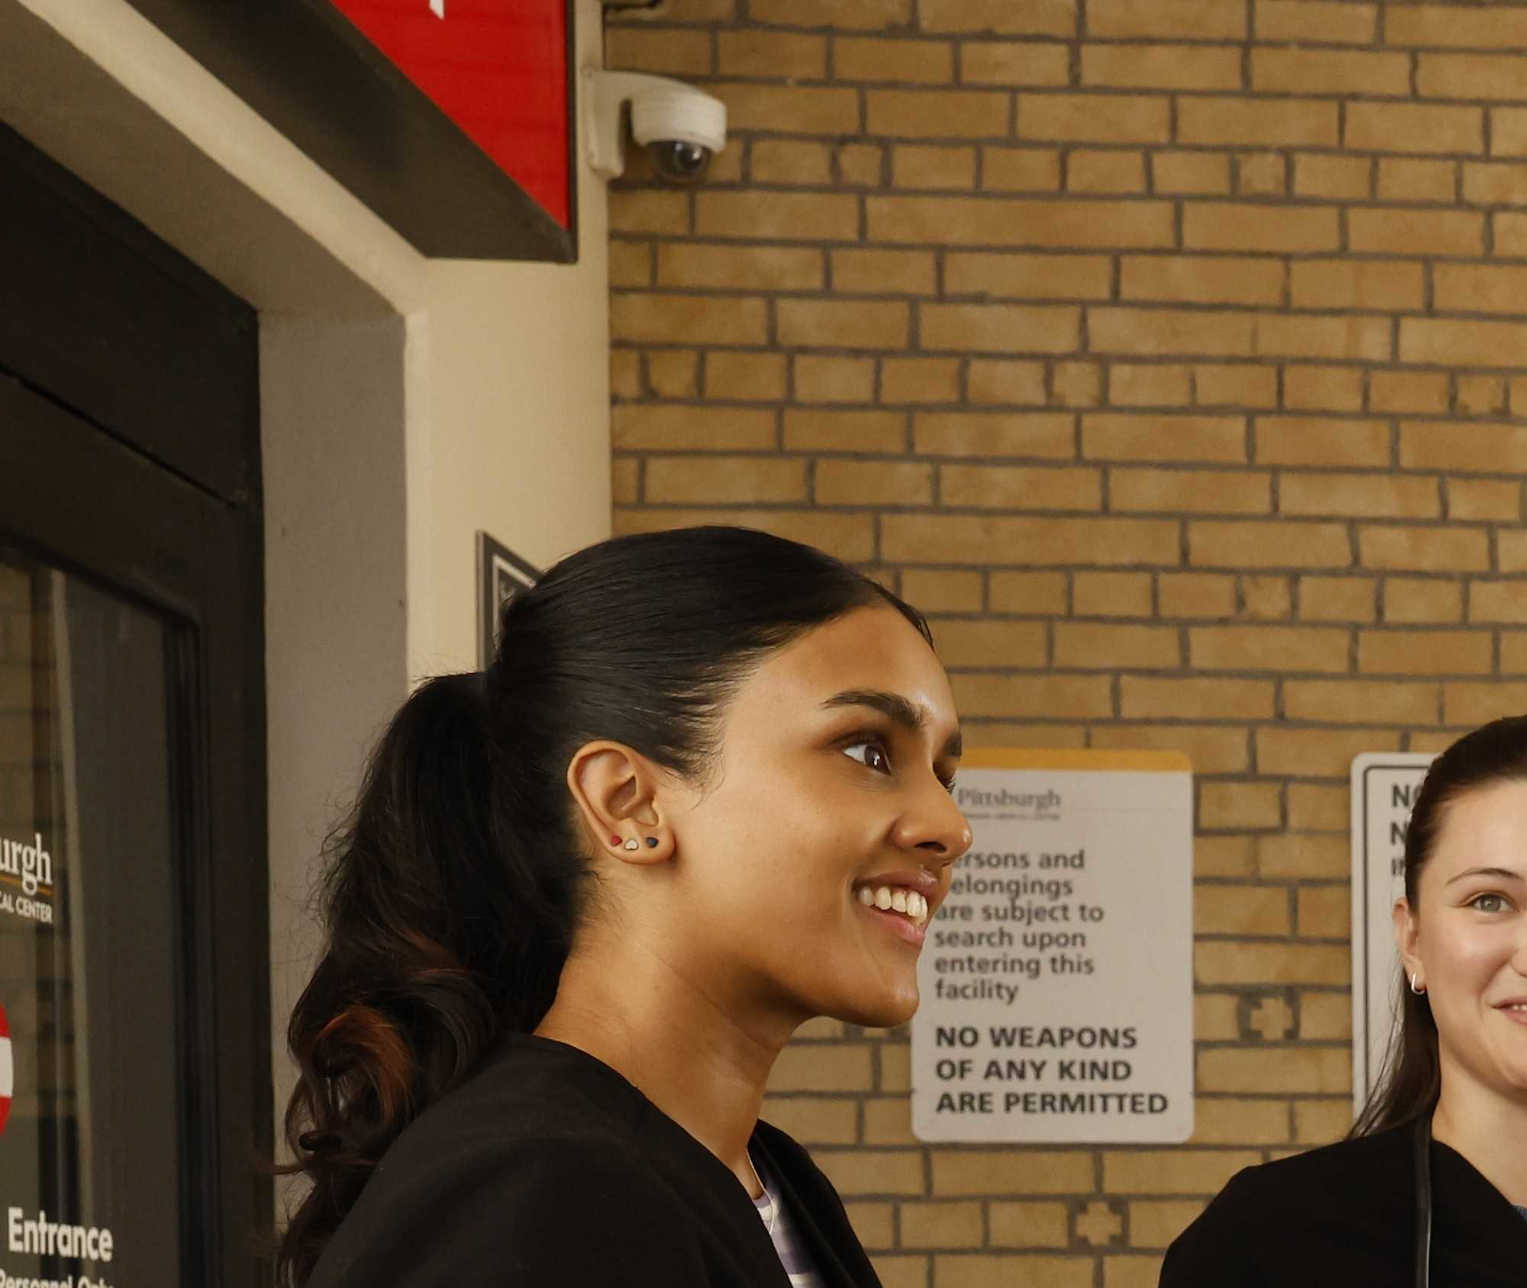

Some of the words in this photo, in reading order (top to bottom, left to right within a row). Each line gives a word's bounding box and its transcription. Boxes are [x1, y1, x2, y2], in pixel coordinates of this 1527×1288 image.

[953, 852, 1030, 868] ersons
[1039, 849, 1085, 868] and
[950, 874, 1074, 901] elongings
[16, 896, 53, 923] CENTER
[936, 904, 973, 921] are
[981, 898, 1069, 927] subject
[1079, 903, 1104, 922] to
[934, 926, 1014, 948] search
[1022, 931, 1086, 953] upon
[934, 953, 1041, 980] entering
[1049, 953, 1095, 975] this
[934, 978, 1020, 1006] facility
[935, 1026, 979, 1049] NO
[989, 1026, 1138, 1049] WEAPONS
[936, 1059, 974, 1082] OF
[983, 1059, 1048, 1082] ANY
[1058, 1059, 1132, 1082] KIND
[935, 1092, 994, 1115] ARE
[1004, 1092, 1169, 1115] PERMITTED
[8, 1206, 114, 1263] Entrance
